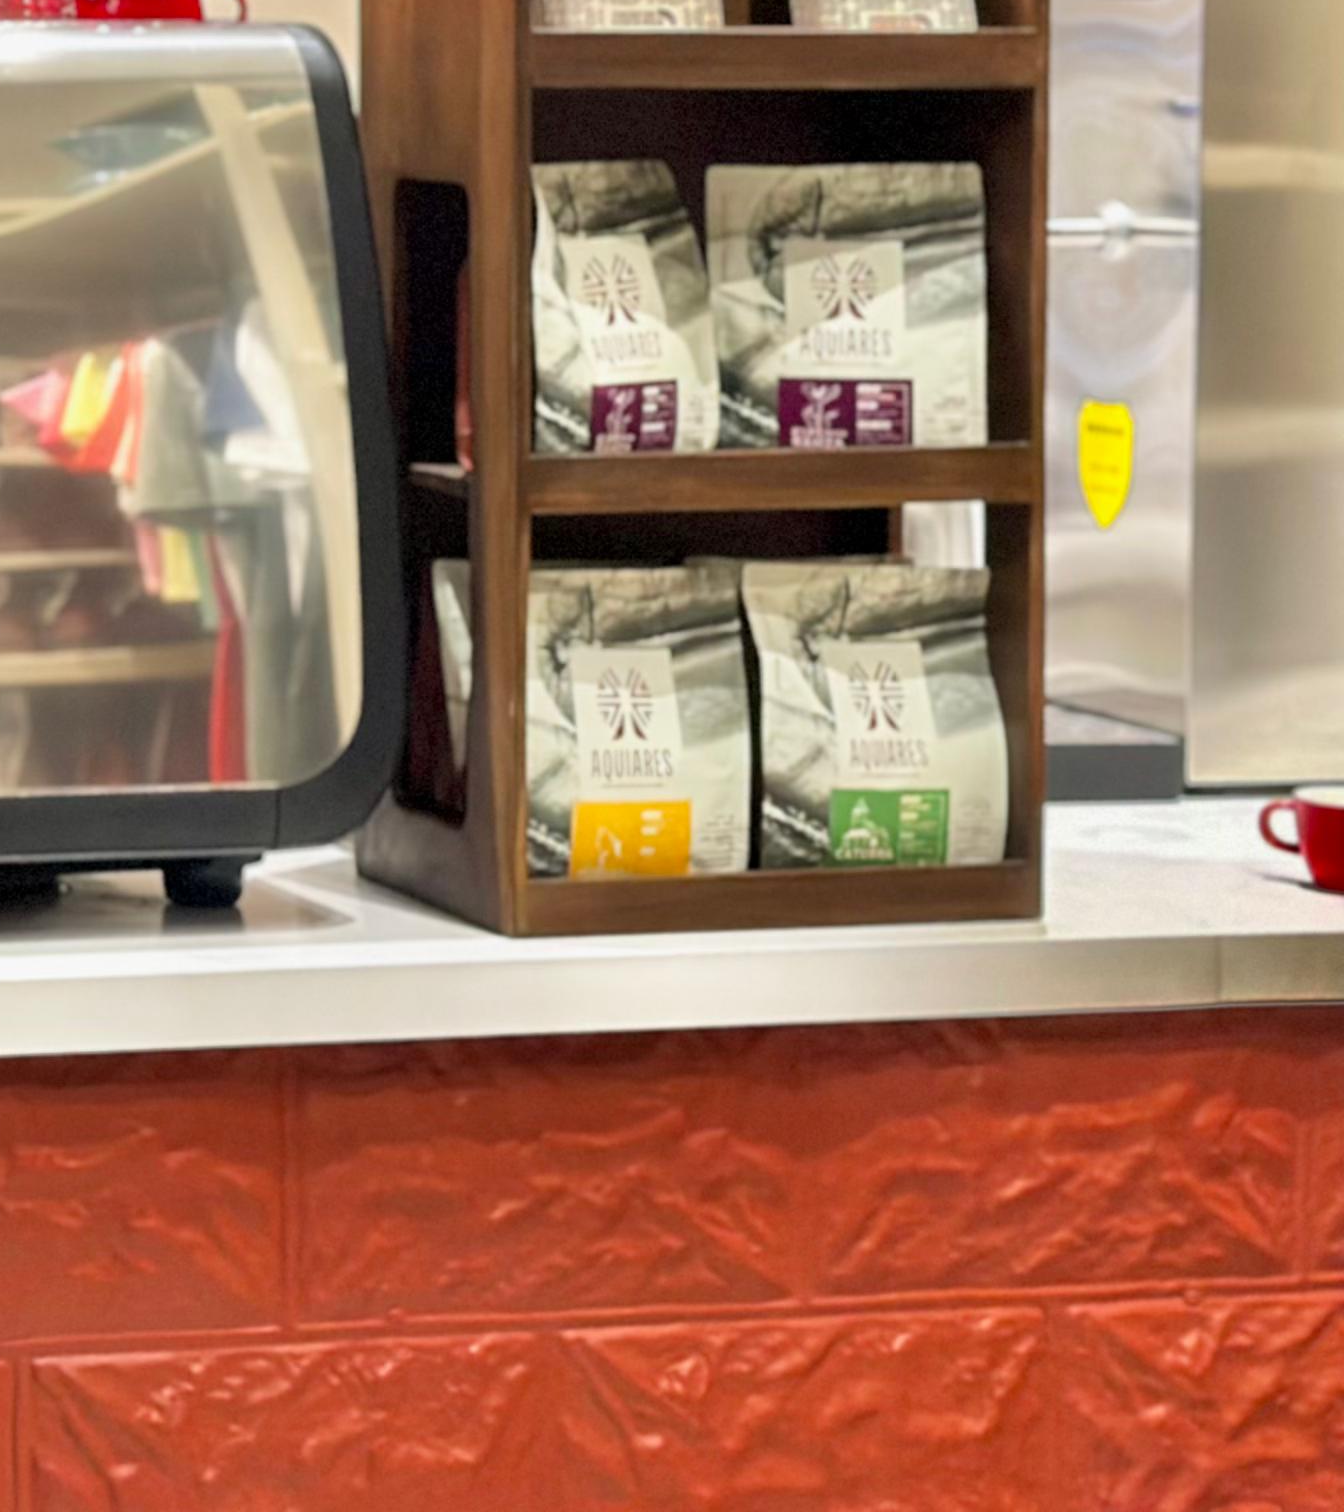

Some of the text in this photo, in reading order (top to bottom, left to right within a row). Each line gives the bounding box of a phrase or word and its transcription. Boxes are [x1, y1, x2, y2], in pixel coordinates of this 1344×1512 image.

[799, 326, 894, 360] AQUIARES
[590, 747, 674, 780] AQUIARES
[849, 737, 930, 771] AQUIARES
